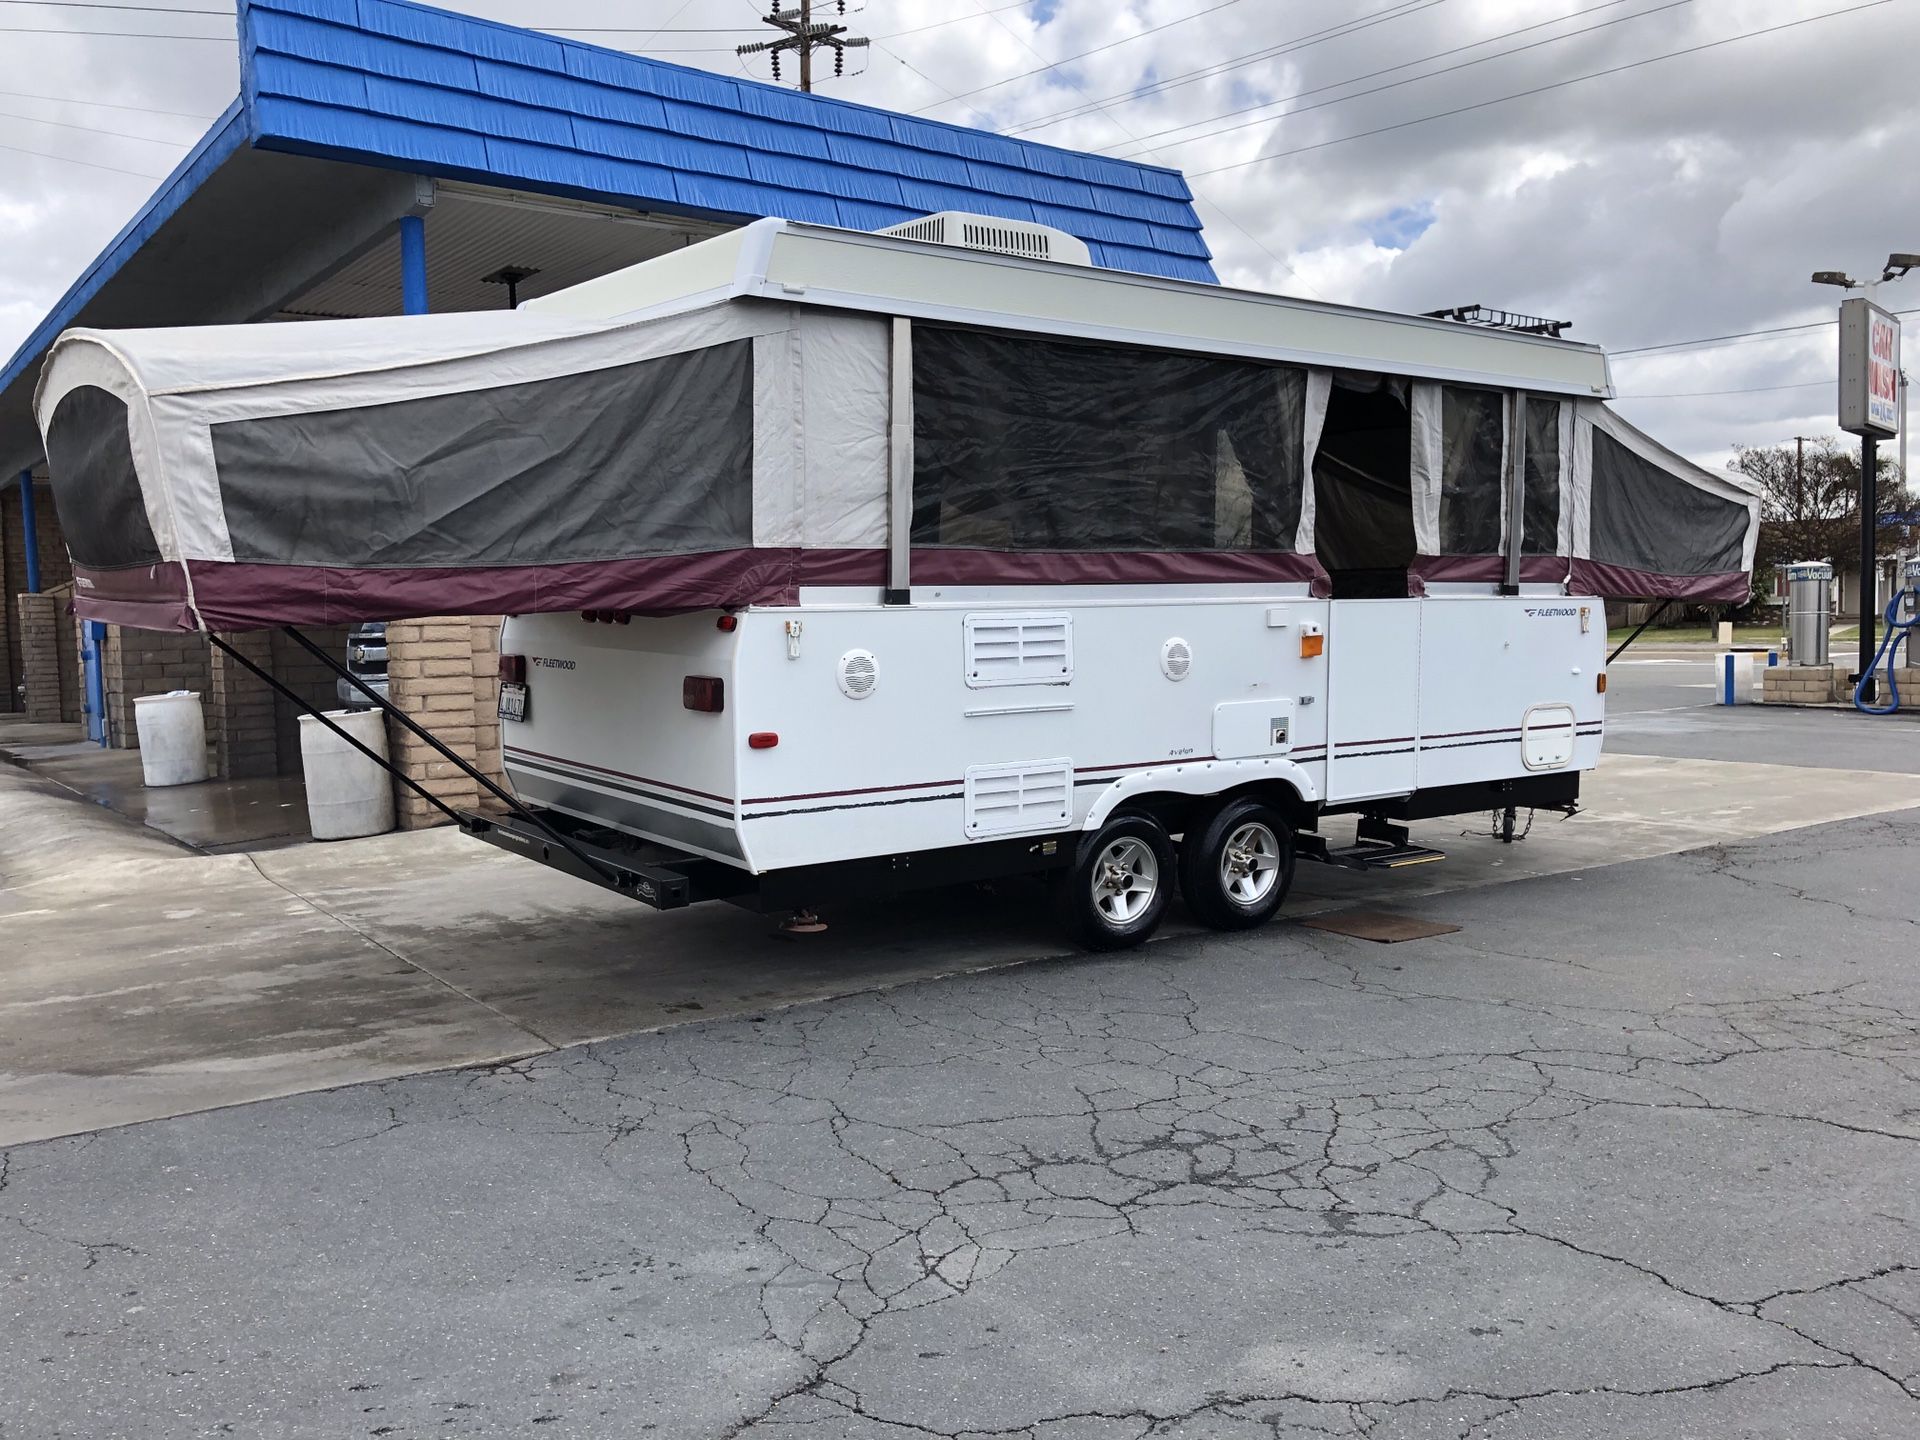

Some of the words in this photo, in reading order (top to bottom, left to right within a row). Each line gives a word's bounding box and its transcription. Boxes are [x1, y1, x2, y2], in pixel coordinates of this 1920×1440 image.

[1872, 320, 1893, 362] CAR
[1868, 358, 1896, 403] WASH
[1537, 608, 1577, 617] FLEETWOOD
[543, 658, 576, 670] FLEETWOOD
